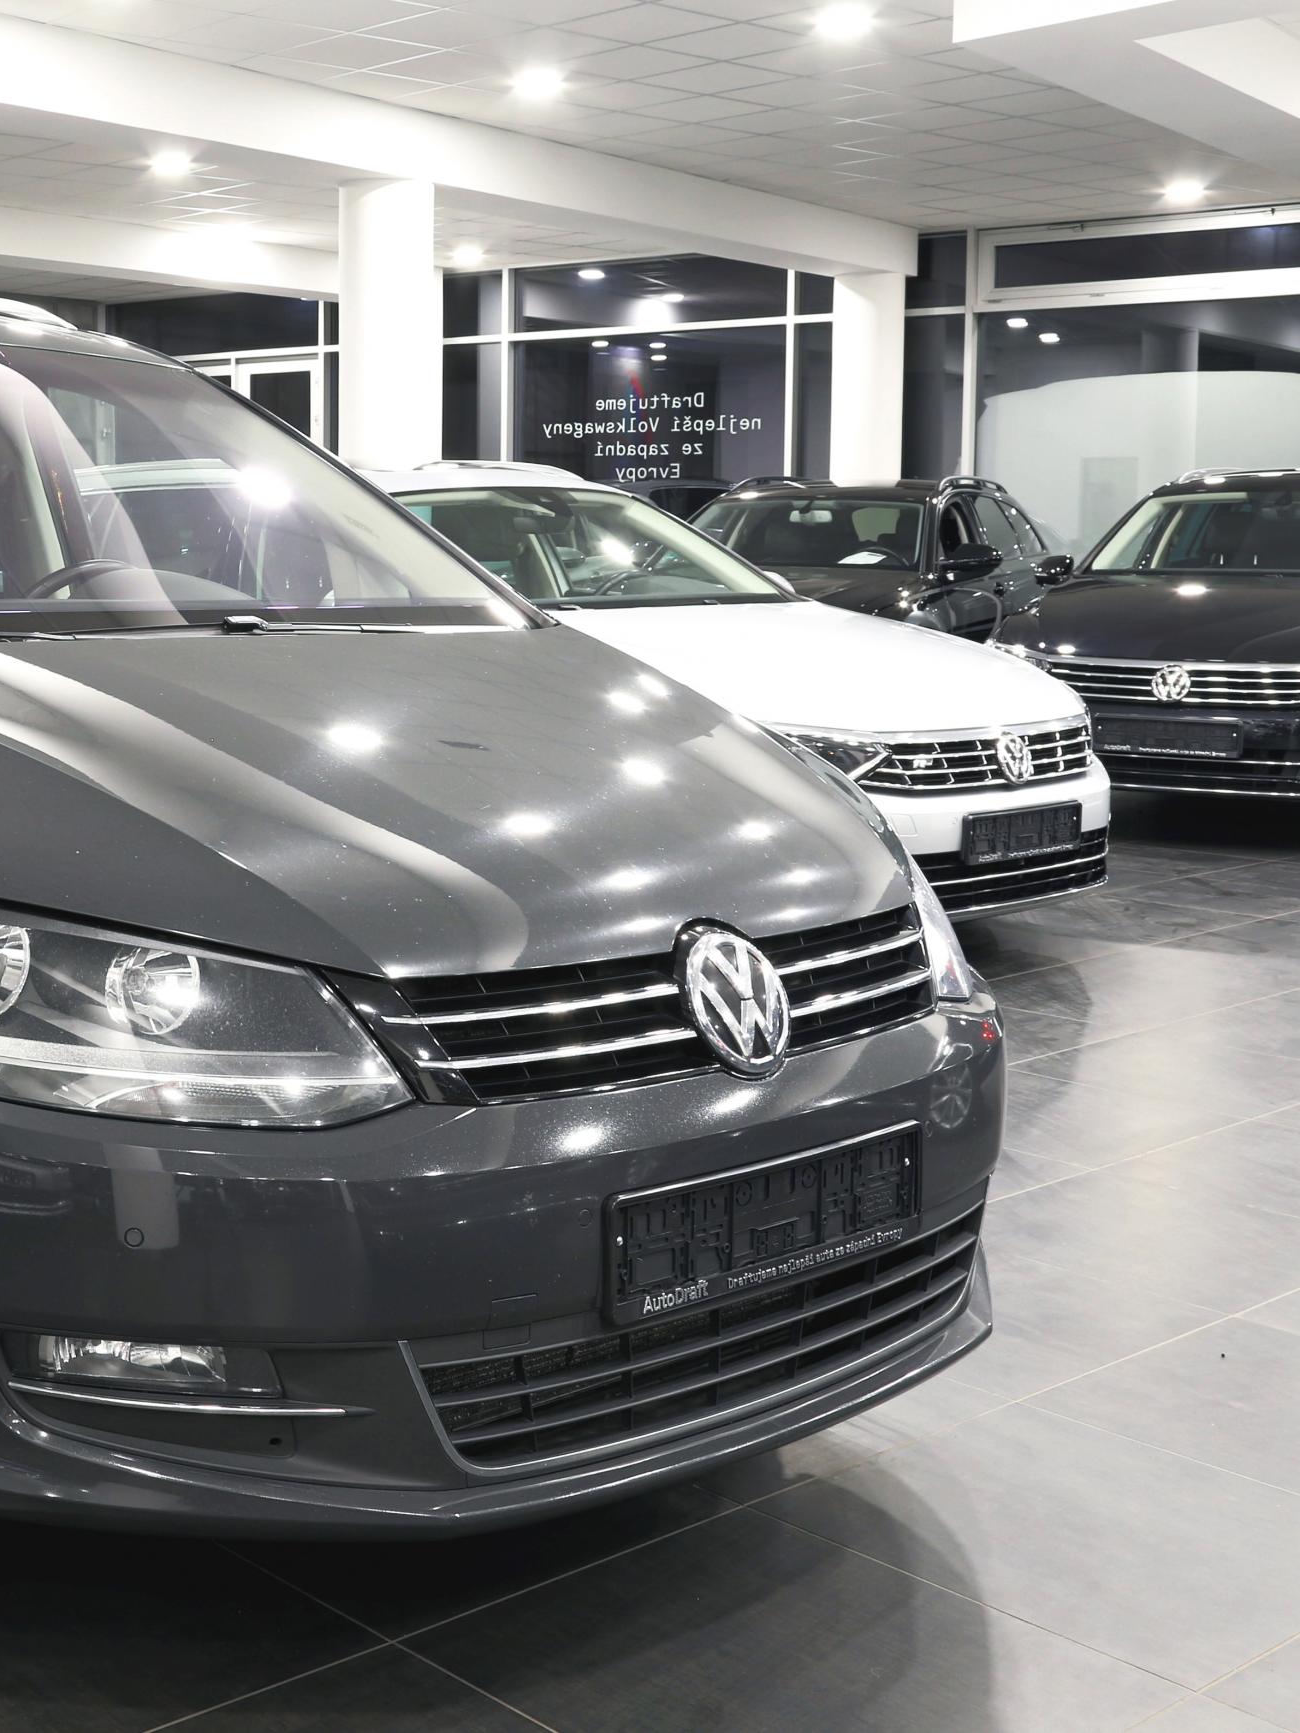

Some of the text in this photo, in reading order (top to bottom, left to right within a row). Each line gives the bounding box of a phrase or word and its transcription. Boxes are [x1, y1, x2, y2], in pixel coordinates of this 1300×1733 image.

[727, 1267, 777, 1290] Draftujeme
[778, 1254, 814, 1275] nejlepší
[816, 1249, 834, 1263] auta
[877, 1227, 903, 1242] Evropy
[643, 1279, 709, 1315] AutoDraft
